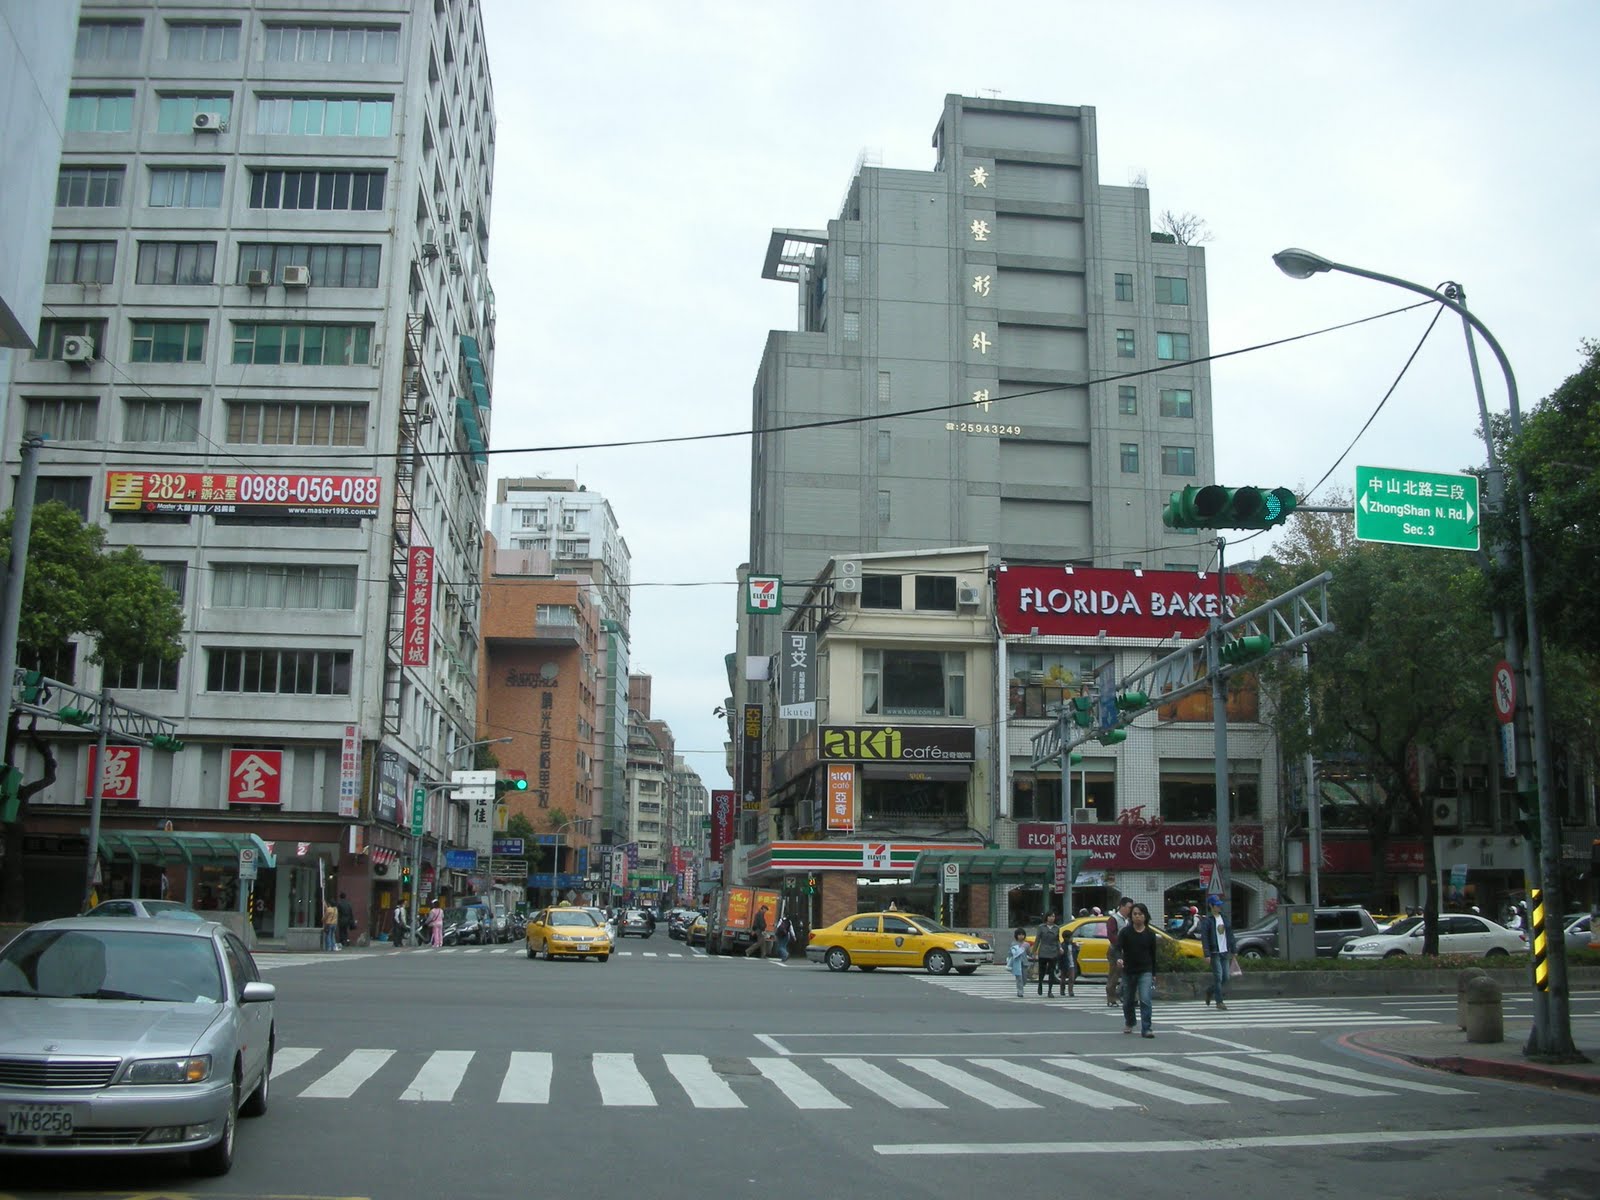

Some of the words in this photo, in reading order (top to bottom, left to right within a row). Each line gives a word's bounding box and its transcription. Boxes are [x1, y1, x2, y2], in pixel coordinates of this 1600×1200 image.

[109, 473, 144, 510] 售
[148, 474, 186, 499] 282
[240, 476, 377, 503] 0988-056-088
[1369, 476, 1464, 500] 中山北路三段
[288, 507, 377, 515] www.master1995.com.tw
[1369, 501, 1431, 517] ZhongShan
[1435, 507, 1446, 519] N.
[1448, 510, 1466, 520] Rd.
[409, 549, 432, 664] 金萬萬名店城
[1019, 587, 1142, 615] FLORIDA
[791, 635, 807, 668] 可艾
[903, 745, 941, 758] café
[233, 754, 278, 798] 金
[1028, 833, 1077, 846] FLORA
[1081, 834, 1121, 846] BAKERY
[1164, 834, 1212, 846] FLORIDA
